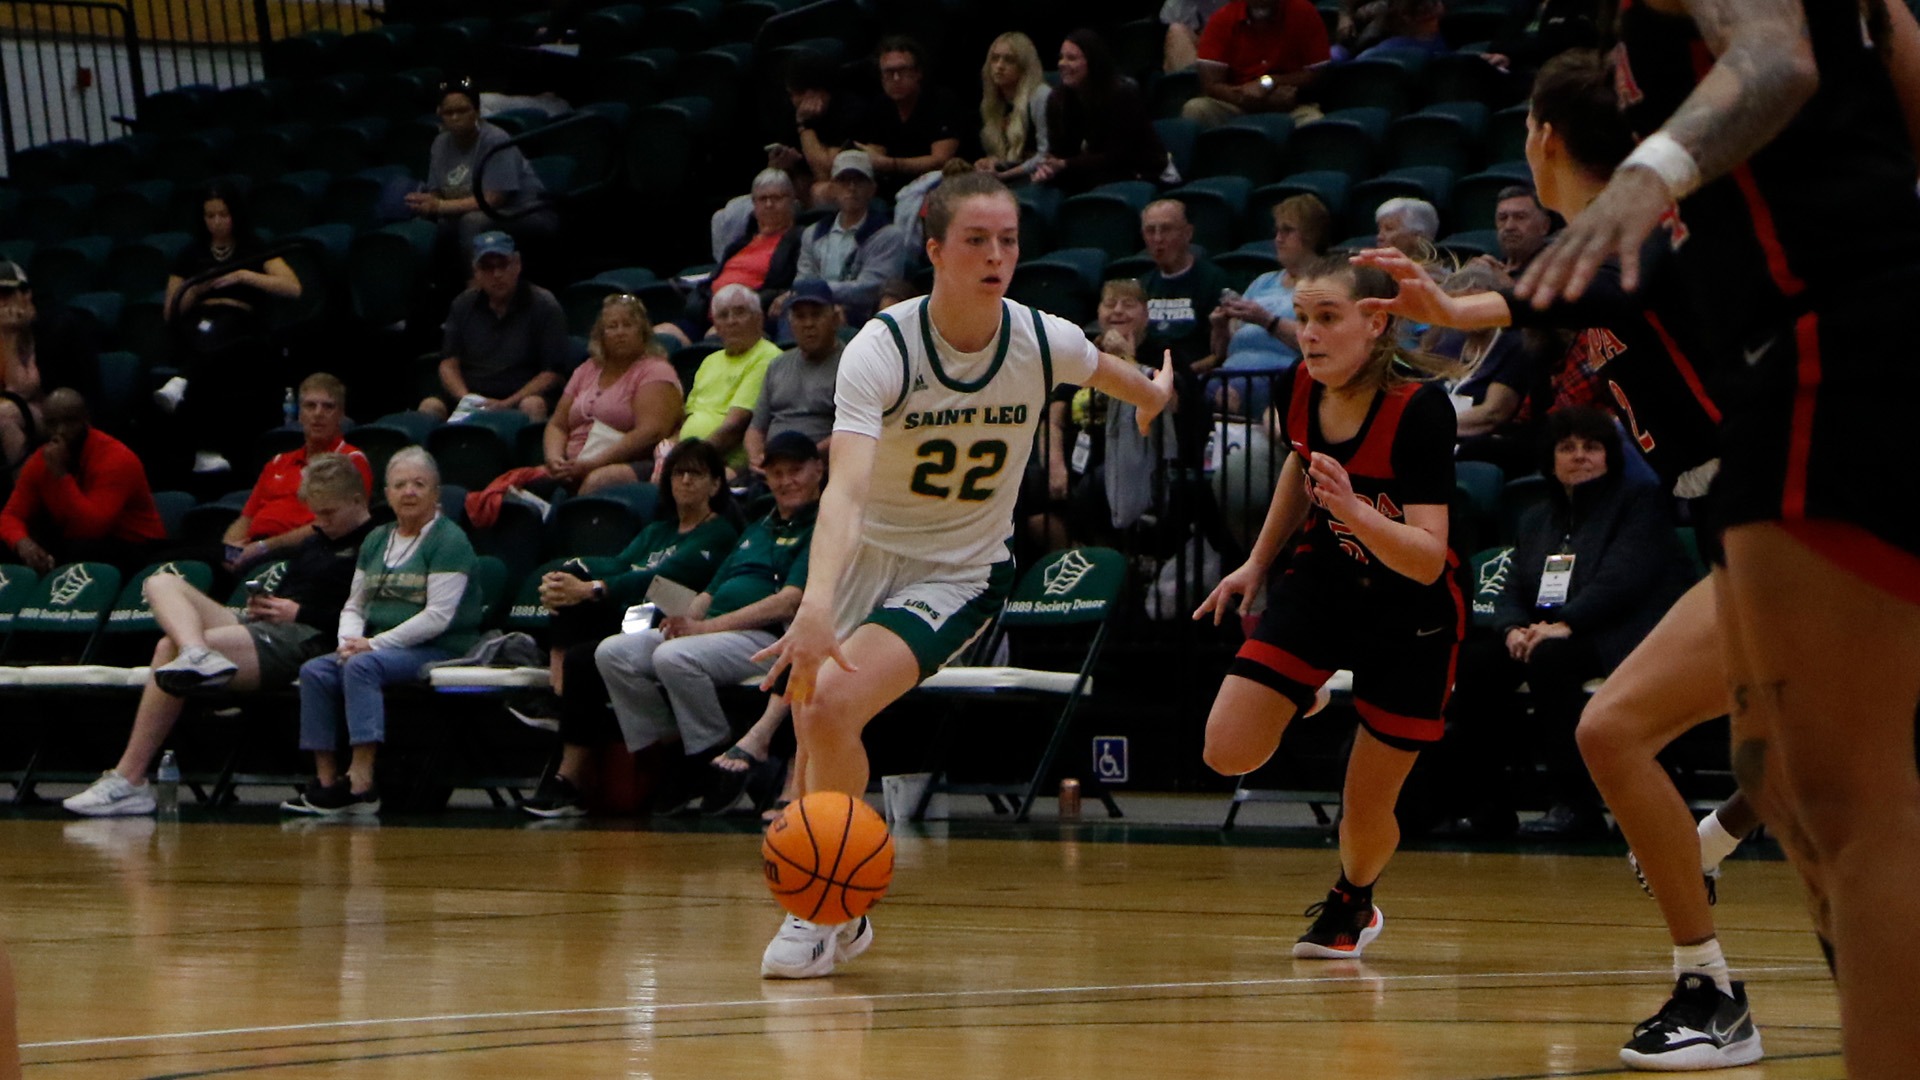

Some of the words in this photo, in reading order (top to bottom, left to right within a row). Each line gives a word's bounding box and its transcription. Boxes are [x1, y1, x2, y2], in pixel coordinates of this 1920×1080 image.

[904, 407, 977, 429] SAINT
[984, 404, 1028, 425] LEO
[910, 438, 1008, 501] 22
[510, 605, 536, 617] 1889
[903, 598, 941, 620] LIONS
[1007, 602, 1032, 613] 1889
[1034, 600, 1072, 614] Society
[1072, 599, 1106, 610] Donor
